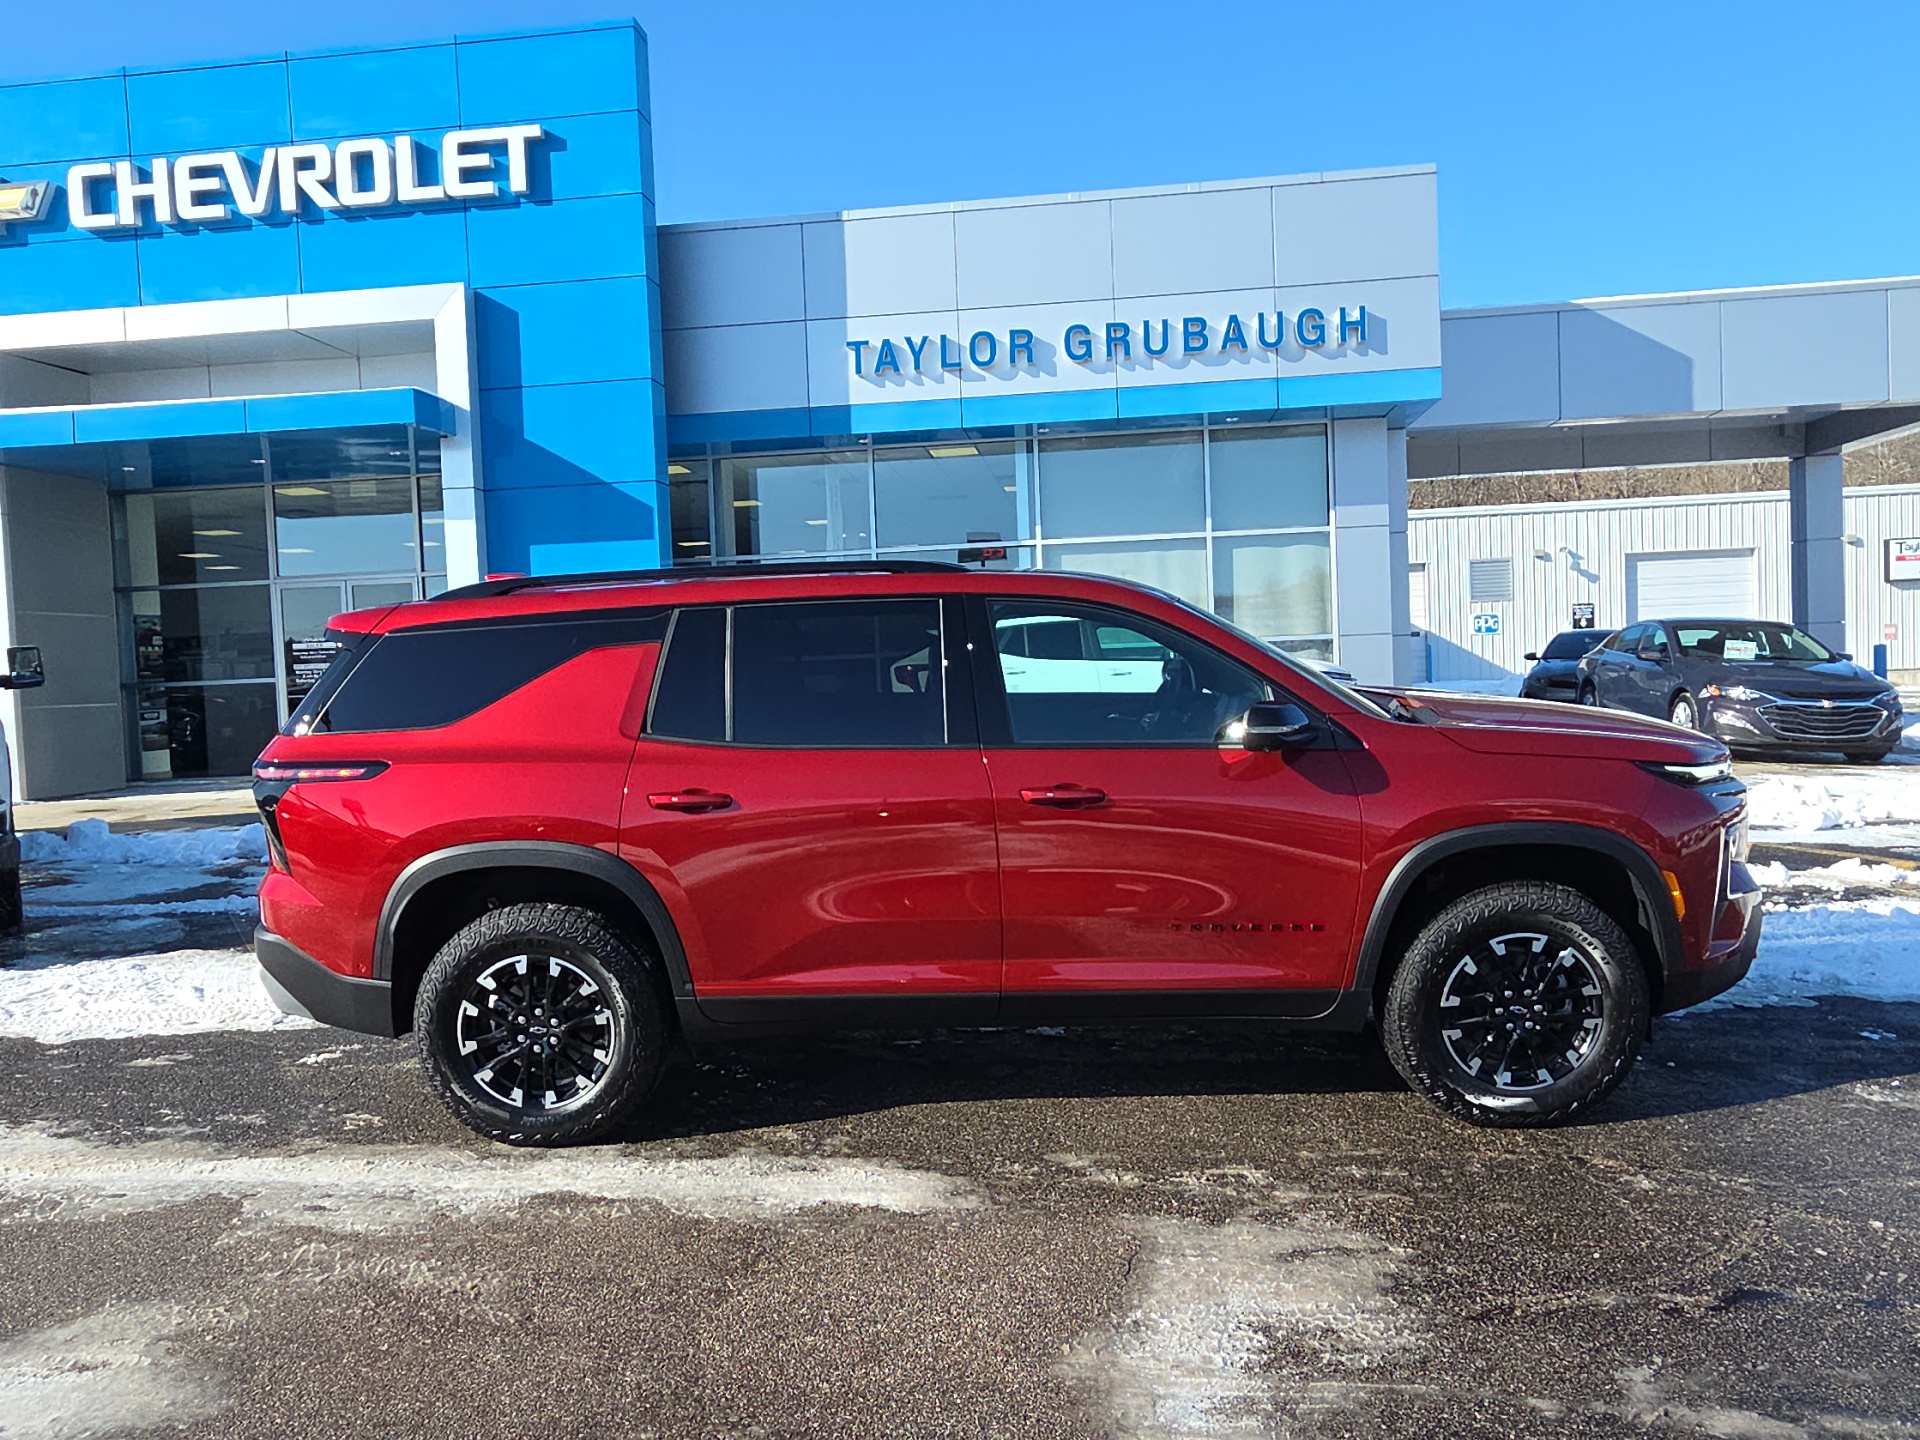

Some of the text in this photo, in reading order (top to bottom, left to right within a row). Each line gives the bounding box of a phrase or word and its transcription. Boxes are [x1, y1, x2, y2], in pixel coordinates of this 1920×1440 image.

[67, 123, 544, 229] CHEVROLET
[846, 305, 1368, 376] TAYLOR GRUBAUGH
[1474, 615, 1499, 632] PPG
[1171, 922, 1326, 933] TRAVERSE
